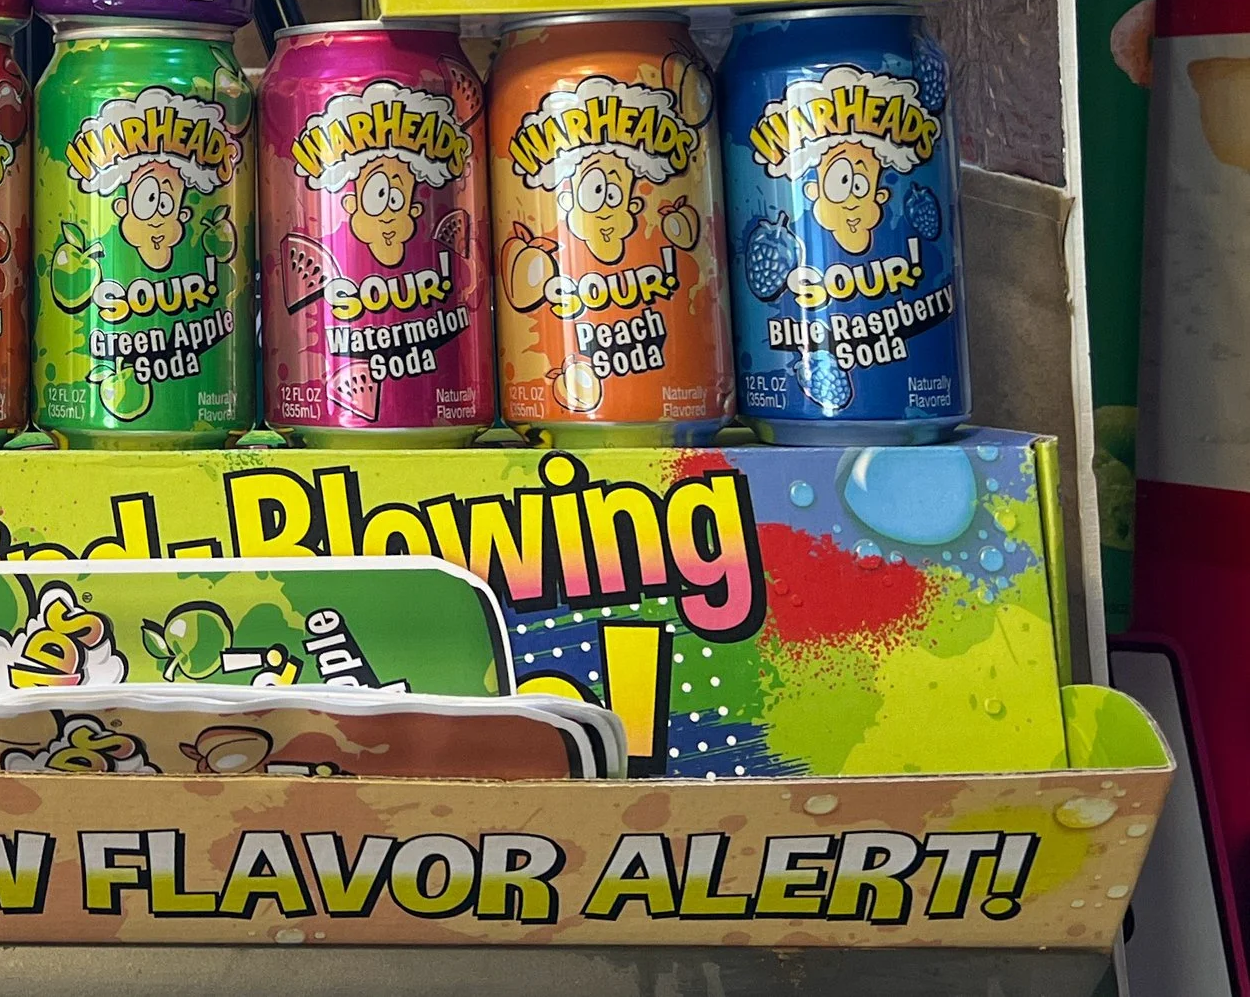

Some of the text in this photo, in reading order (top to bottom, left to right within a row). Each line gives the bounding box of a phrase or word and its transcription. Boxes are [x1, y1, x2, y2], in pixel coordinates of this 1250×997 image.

[65, 106, 237, 181] WARHEADS
[290, 101, 469, 179] WARHEADS
[509, 96, 695, 174] WARHEADS
[749, 86, 938, 165] WARHEADS
[93, 257, 218, 322] SOUR!
[324, 251, 452, 321] SOUR!
[543, 246, 677, 319] SOUR!
[788, 238, 922, 308] SOUR!
[89, 309, 234, 358] Green Apple
[326, 306, 470, 354] Watermelon
[575, 308, 666, 352] Peach
[768, 282, 954, 349] Blue Raspberry
[136, 350, 200, 383] Soda
[369, 348, 436, 380] Soda
[592, 343, 664, 379] Soda
[836, 335, 908, 370] Soda
[280, 387, 321, 401] 12 FL OZ
[281, 403, 321, 420] (355mL)
[436, 388, 477, 405] Naturally
[81, 829, 564, 924] FLAVOR
[584, 830, 1041, 925] ALERT!
